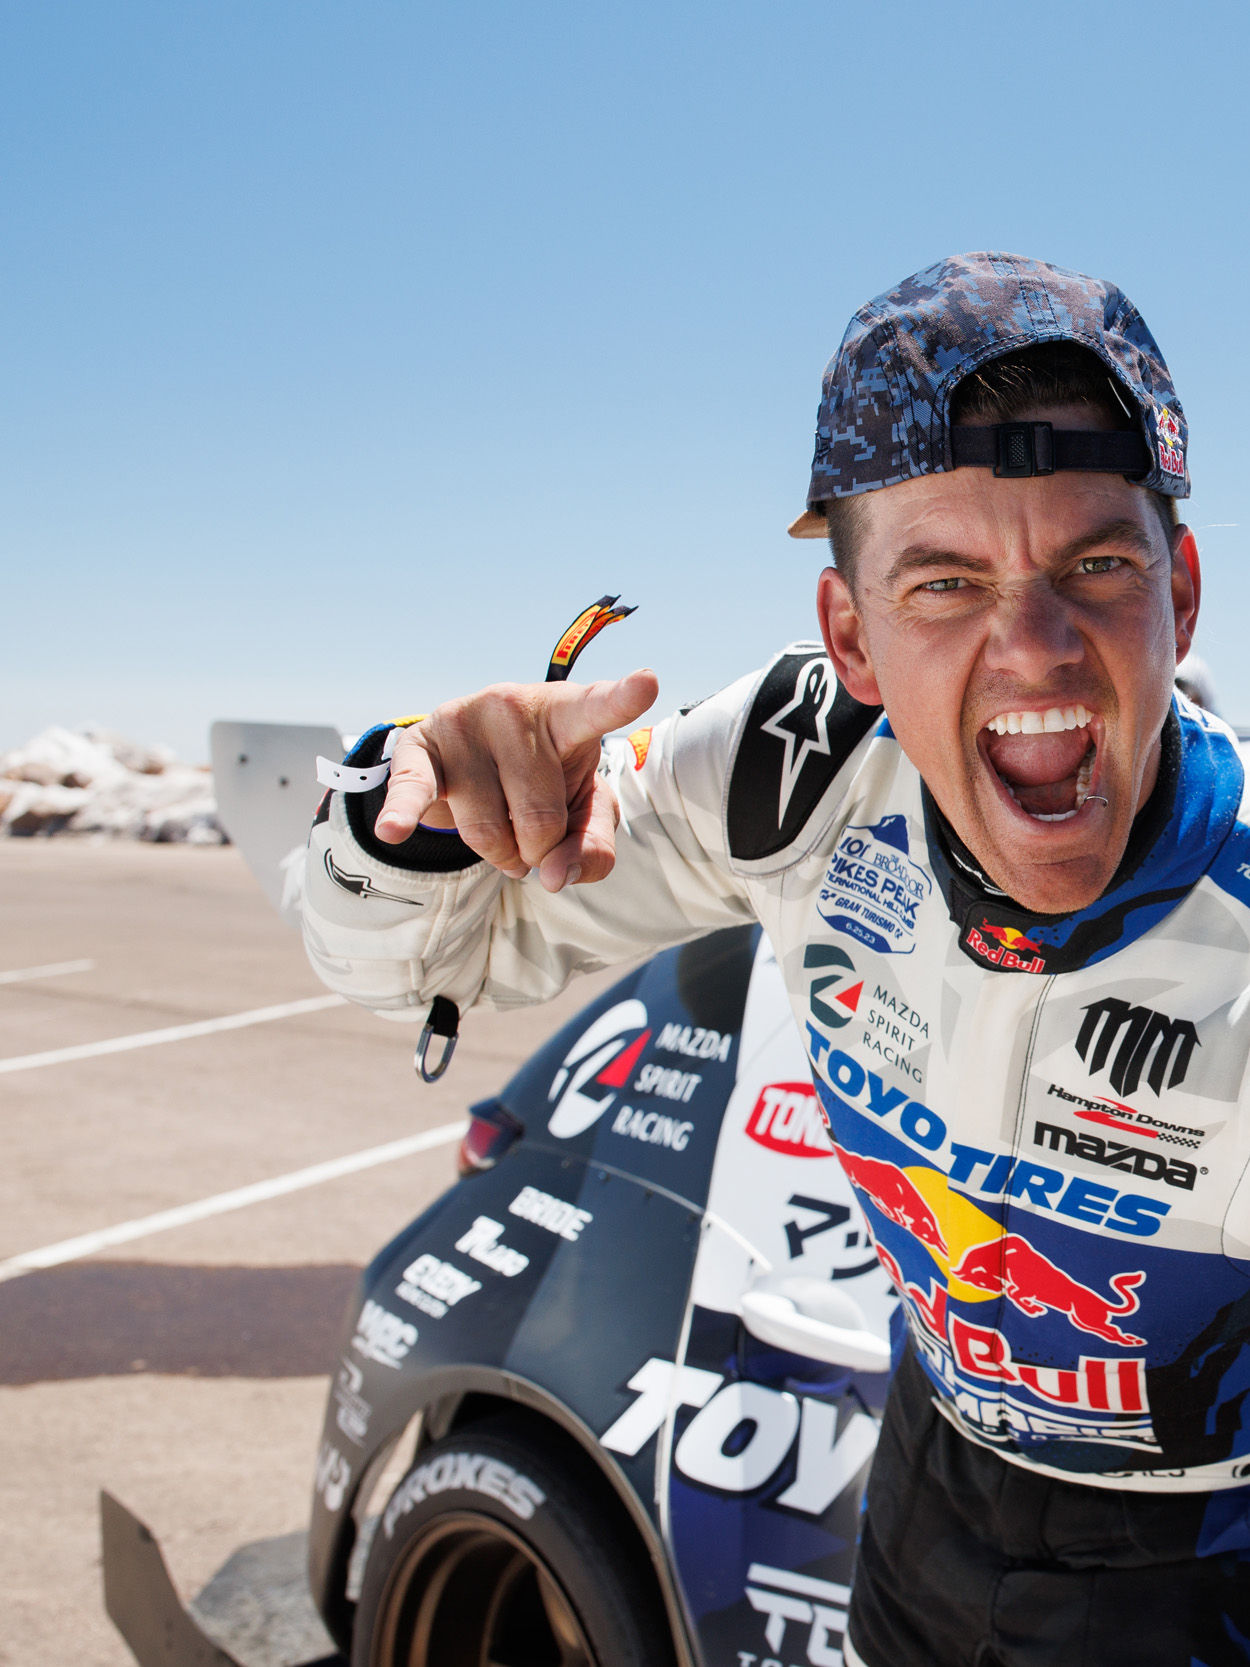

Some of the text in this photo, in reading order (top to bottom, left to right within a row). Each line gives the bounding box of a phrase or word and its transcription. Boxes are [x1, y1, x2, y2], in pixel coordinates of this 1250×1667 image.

[826, 870, 881, 904] TERNATIONAL
[834, 896, 896, 933] GRAN TURISMO
[966, 927, 1046, 973] Red Bull
[867, 1009, 915, 1051] SPIRIT
[873, 985, 929, 1039] MAZDA
[655, 1022, 732, 1062] MAZDA
[863, 1031, 922, 1083] RACING
[634, 1063, 702, 1103] SPIRIT
[611, 1105, 694, 1151] RACING
[754, 1087, 832, 1150] TON
[805, 1019, 1172, 1237] TOYO TIRES
[1047, 1084, 1206, 1137] Hampton Downs
[948, 1310, 1150, 1414] Bull
[600, 1357, 880, 1516] TOY
